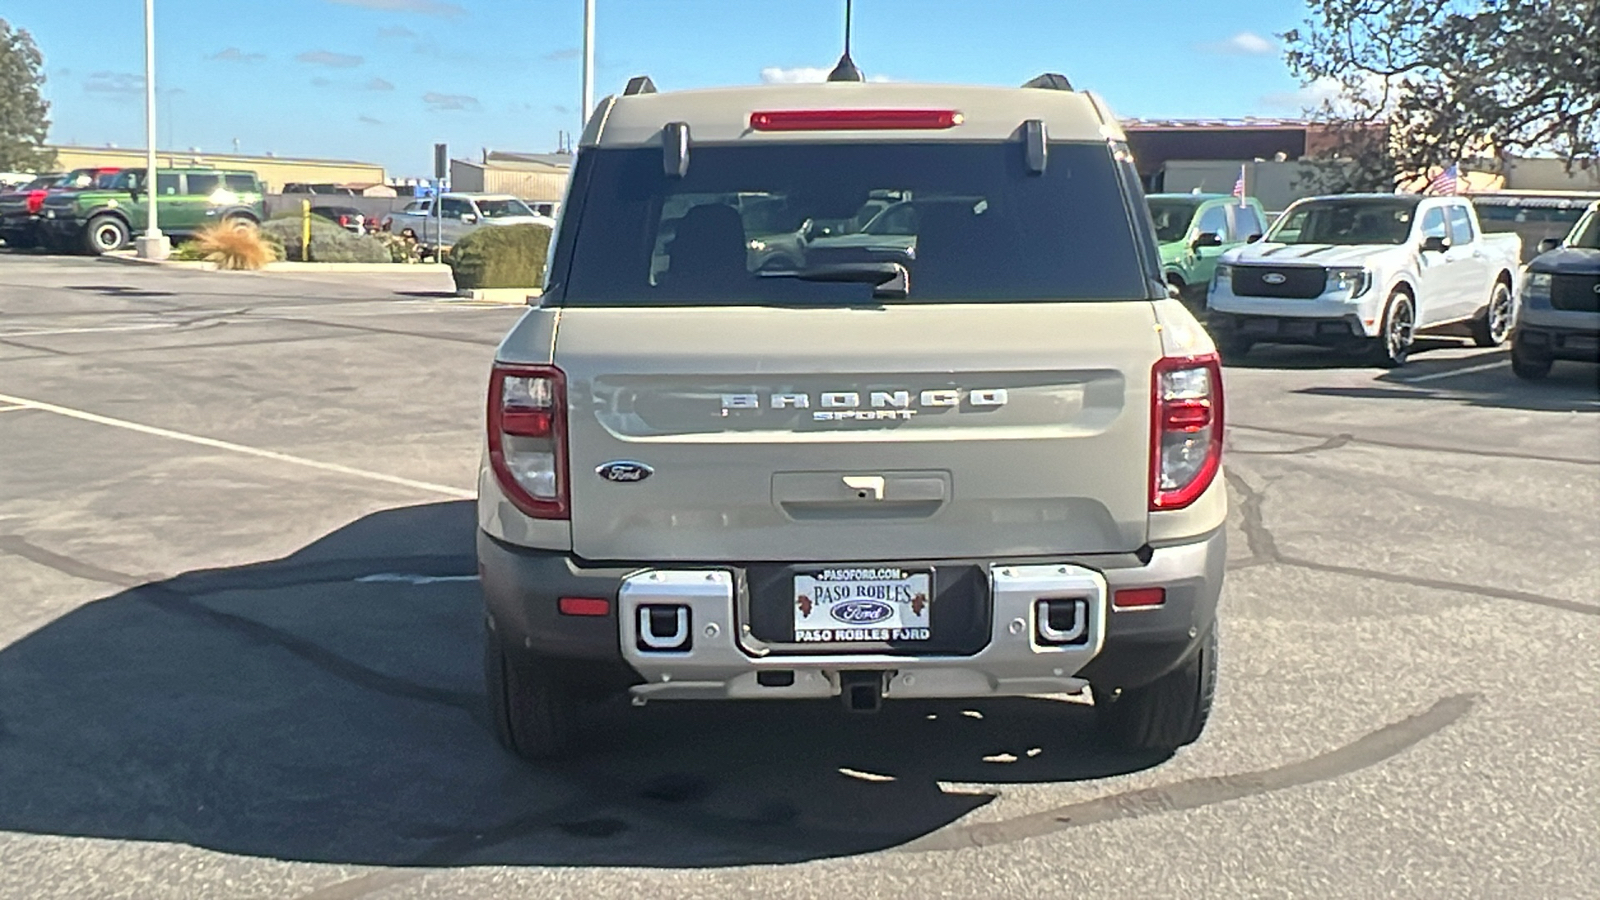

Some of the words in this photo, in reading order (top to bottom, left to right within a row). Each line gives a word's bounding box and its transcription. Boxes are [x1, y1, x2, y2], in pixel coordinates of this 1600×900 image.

[721, 388, 1008, 409] BRONCO
[813, 410, 918, 421] SPORT
[608, 465, 641, 480] Ford
[823, 568, 901, 581] PASOFORD.COM
[814, 585, 851, 606] PASO
[856, 584, 912, 602] ROBLES
[843, 603, 882, 620] Ford
[795, 629, 832, 642] PASO
[835, 629, 890, 641] ROBLES
[893, 628, 930, 641] FORD
